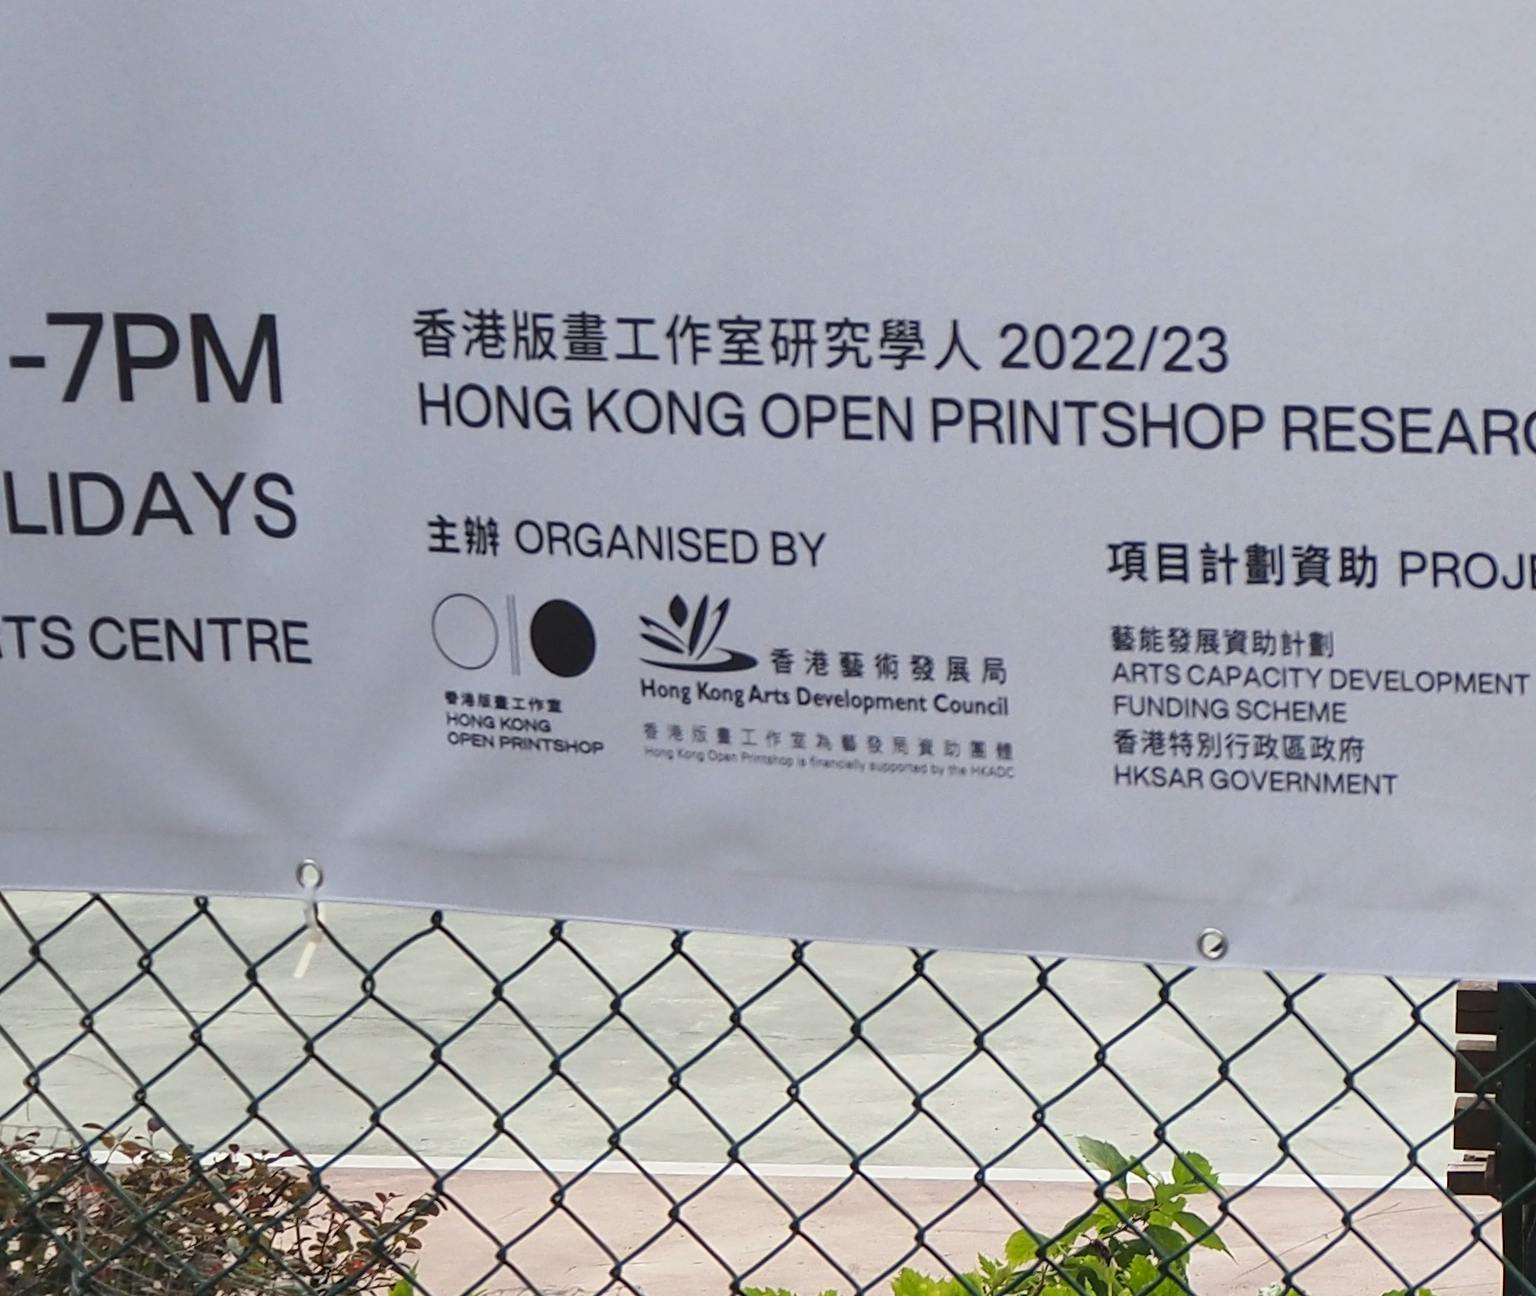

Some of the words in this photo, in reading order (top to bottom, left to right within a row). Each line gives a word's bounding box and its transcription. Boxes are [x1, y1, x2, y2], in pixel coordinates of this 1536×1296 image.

[8, 311, 283, 404] -7PM
[412, 307, 981, 371] 香港版畫工作室研究學人
[999, 322, 1229, 374] 2022/23
[418, 381, 572, 432] HONG
[587, 387, 746, 438] KONG
[760, 392, 914, 442] OPEN
[931, 397, 1265, 450] PRINTSHOP
[427, 514, 500, 557] 主辦
[514, 519, 759, 565] ORGANISED
[770, 530, 826, 568] BY
[1107, 540, 1378, 589] 項目計劃資助
[0, 614, 76, 660] TS
[88, 616, 313, 665] CENTRE
[1111, 625, 1334, 659] 藝能發展資助計劃
[770, 647, 1007, 685] 香港藝術發展局
[1112, 661, 1181, 686] ARTS
[1186, 663, 1323, 689] CAPACITY
[1329, 668, 1531, 695] DEVELOPMENT
[639, 678, 692, 706] Hong
[696, 681, 745, 709] Kong
[748, 684, 791, 705] Arts
[795, 686, 928, 715] Development
[932, 693, 1009, 716] Council
[1113, 694, 1230, 721] FUNDING
[1235, 698, 1347, 724] SCHEME
[446, 713, 496, 729] HONG
[499, 717, 552, 734] KONG
[447, 731, 495, 749] OPEN
[498, 735, 605, 755] PRINTSHOP
[1113, 728, 1365, 764] 香港特別行政區政府
[1114, 765, 1204, 789] HKSAR
[1209, 768, 1398, 796] GOVERNMENT
